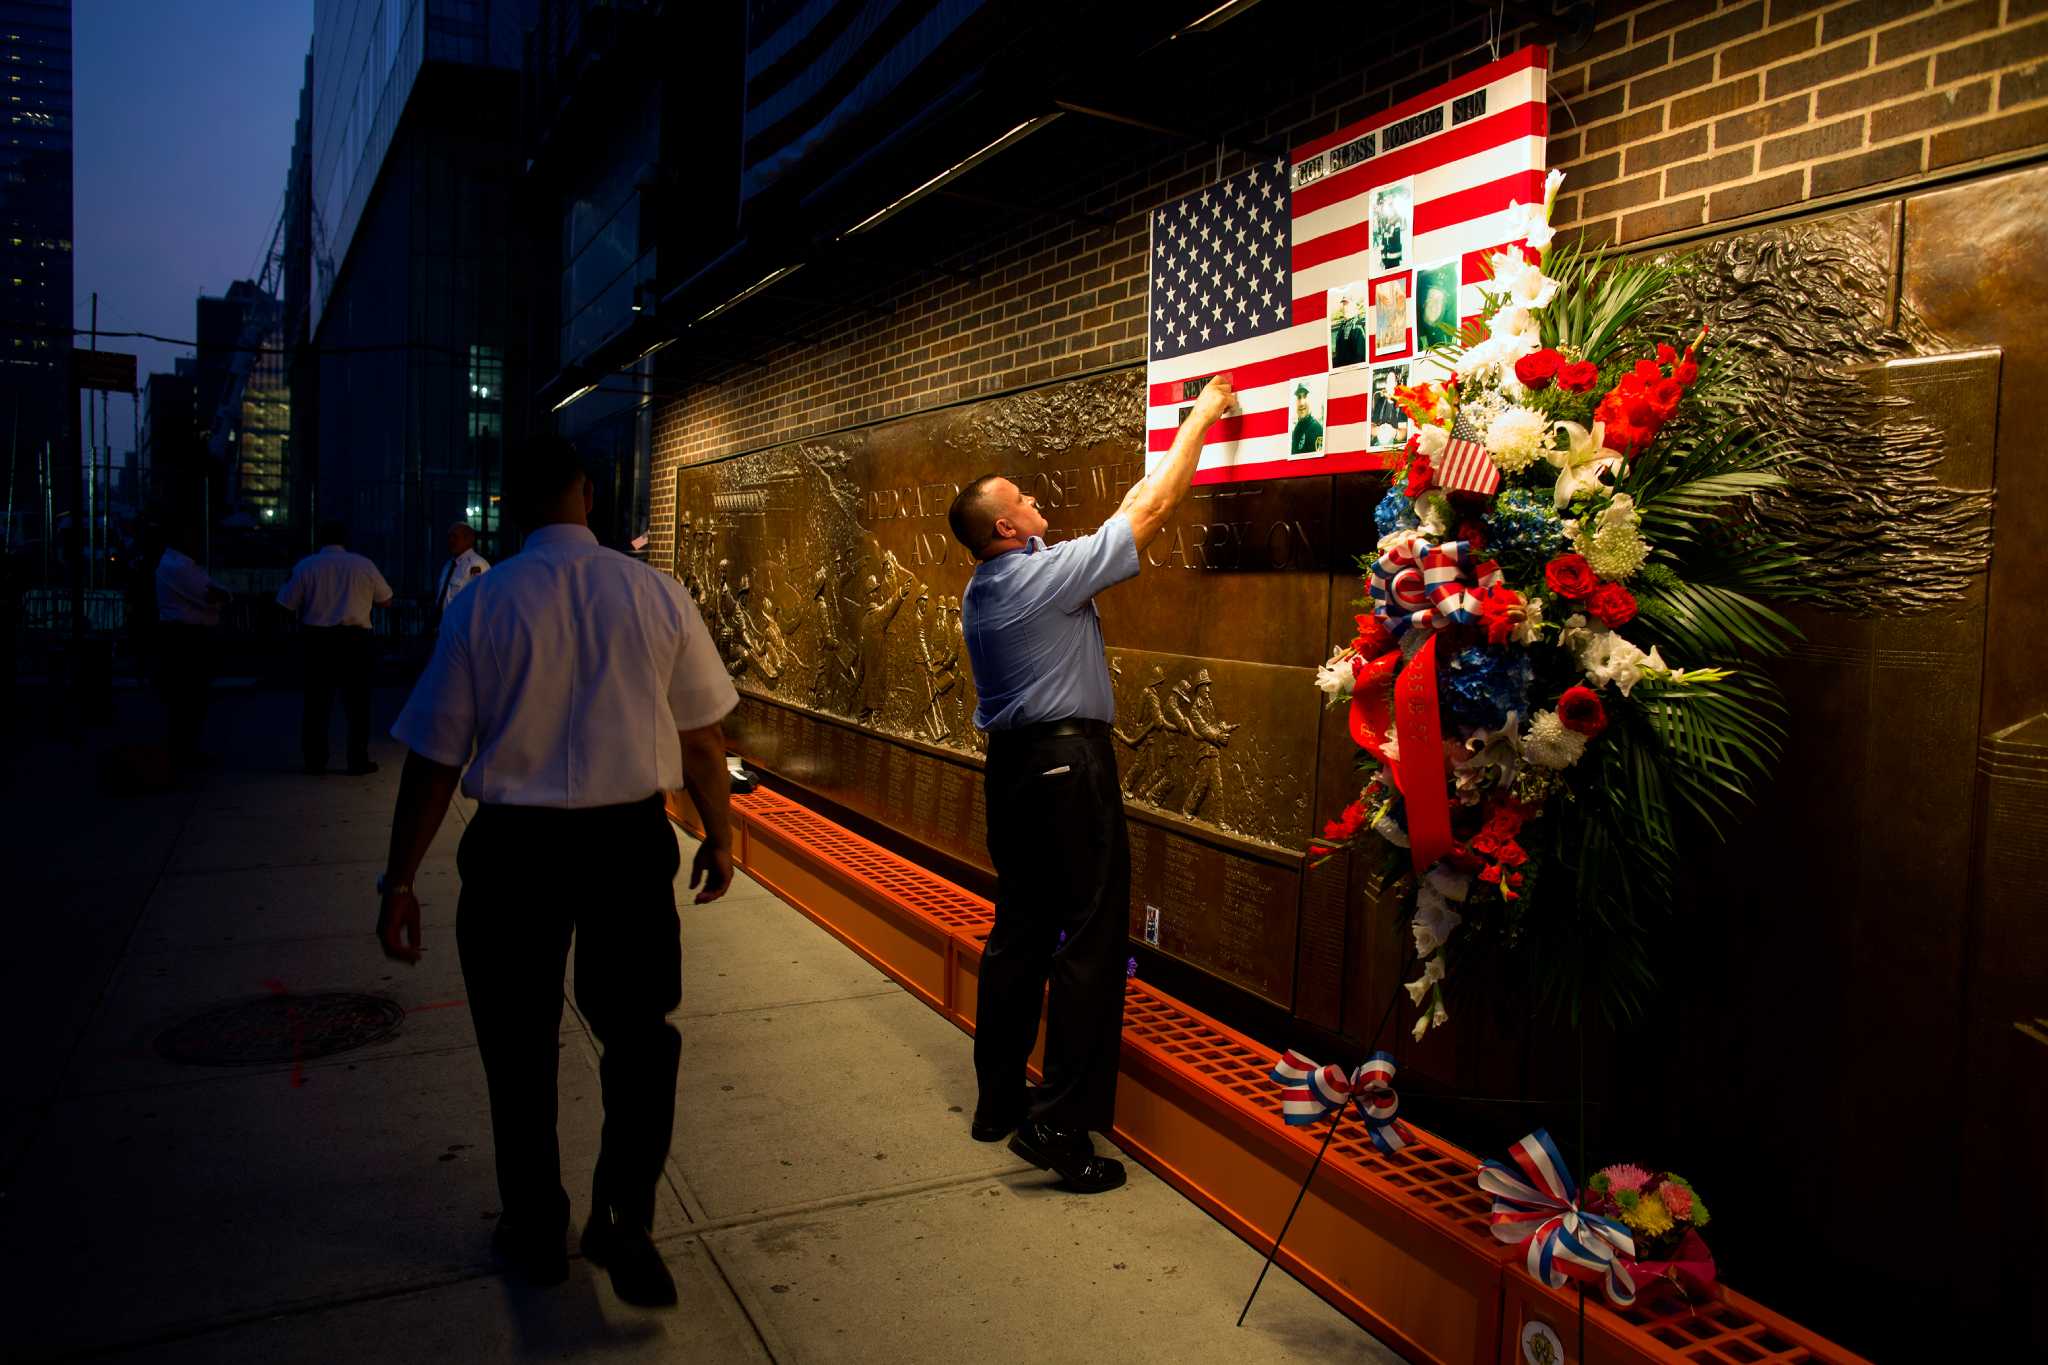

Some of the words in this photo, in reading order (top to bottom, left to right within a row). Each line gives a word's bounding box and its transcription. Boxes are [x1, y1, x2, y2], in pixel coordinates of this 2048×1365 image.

[1299, 156, 1324, 186] GOD
[1330, 134, 1376, 172] BLESS
[1382, 106, 1444, 152] MONROE
[910, 532, 949, 566] AND
[1147, 520, 1254, 569] CARRY
[1265, 519, 1323, 569] ON
